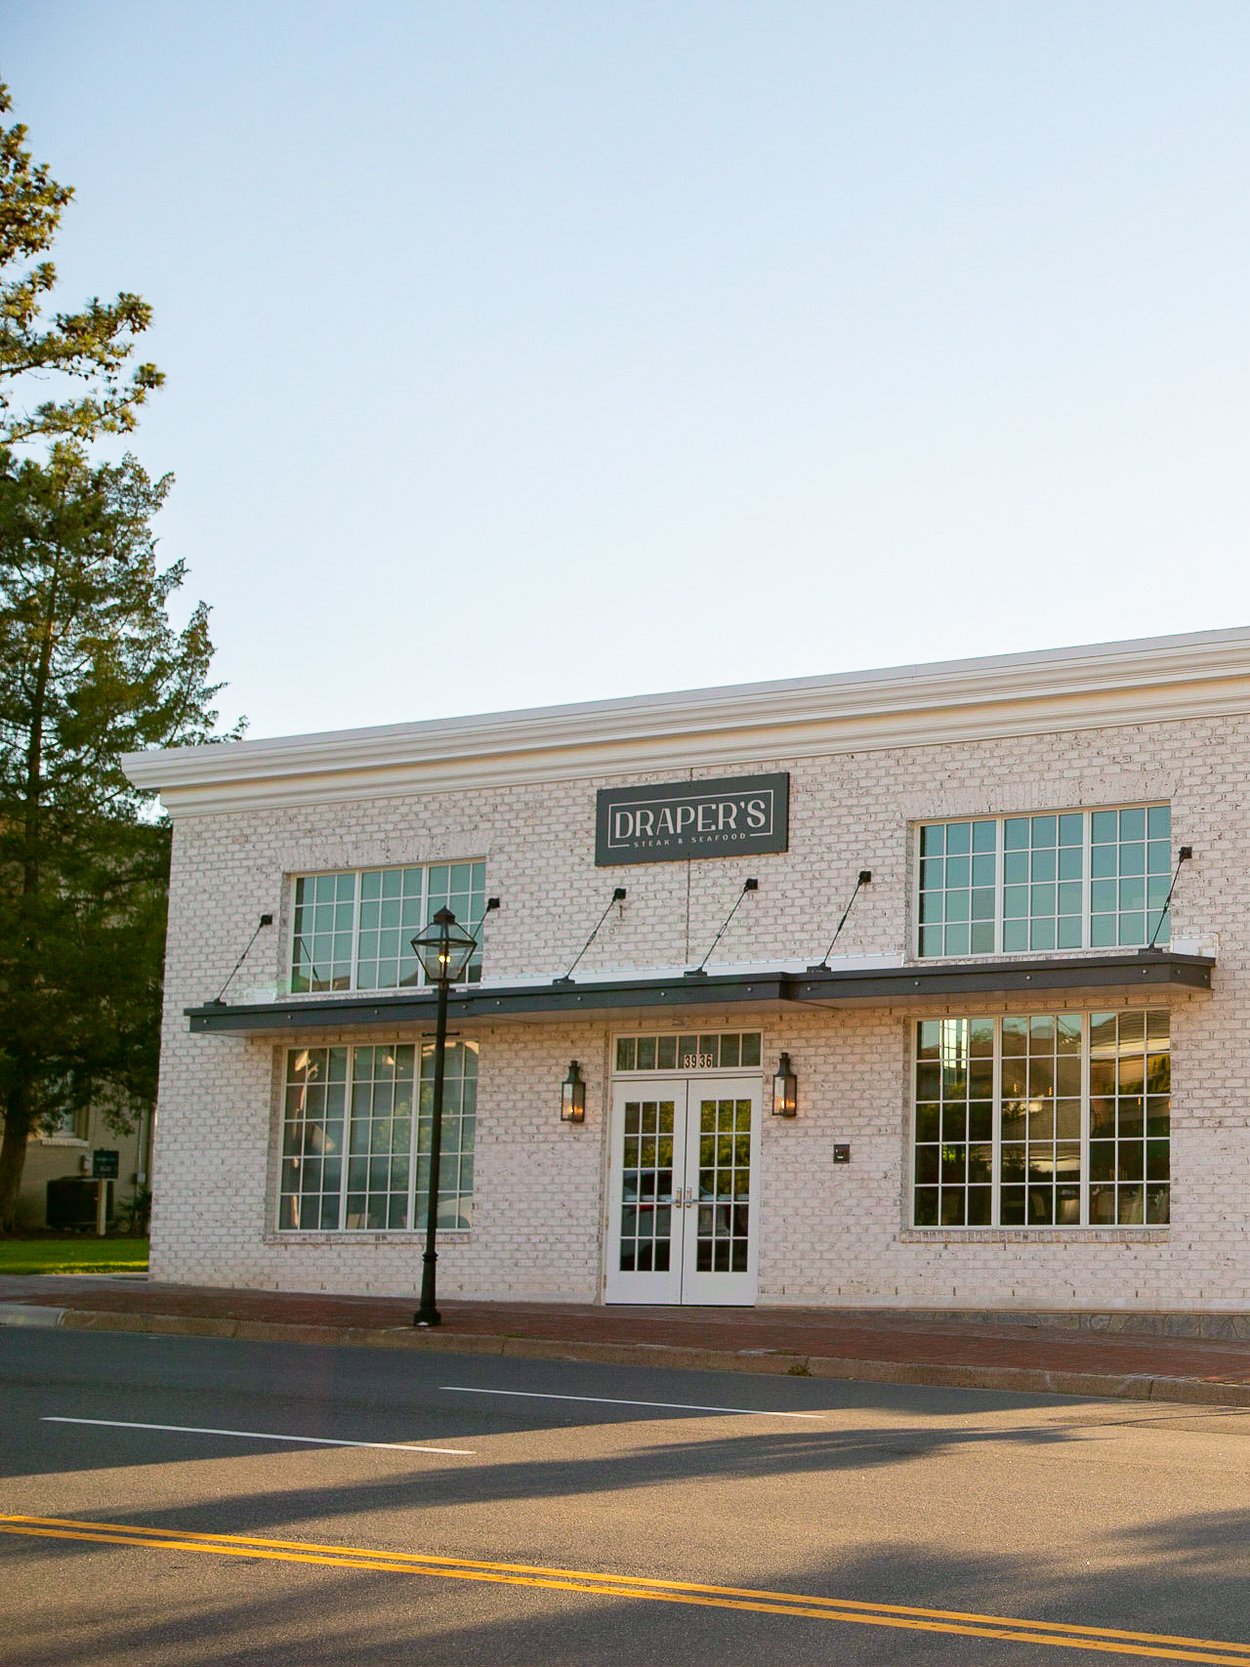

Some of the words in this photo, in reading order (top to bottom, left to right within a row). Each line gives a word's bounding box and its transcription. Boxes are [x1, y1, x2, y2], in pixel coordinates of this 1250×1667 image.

[615, 799, 766, 839] DRAPER'S
[633, 839, 670, 849] STEAK
[691, 832, 746, 844] SEAFOOD
[684, 1054, 712, 1069] 3936
